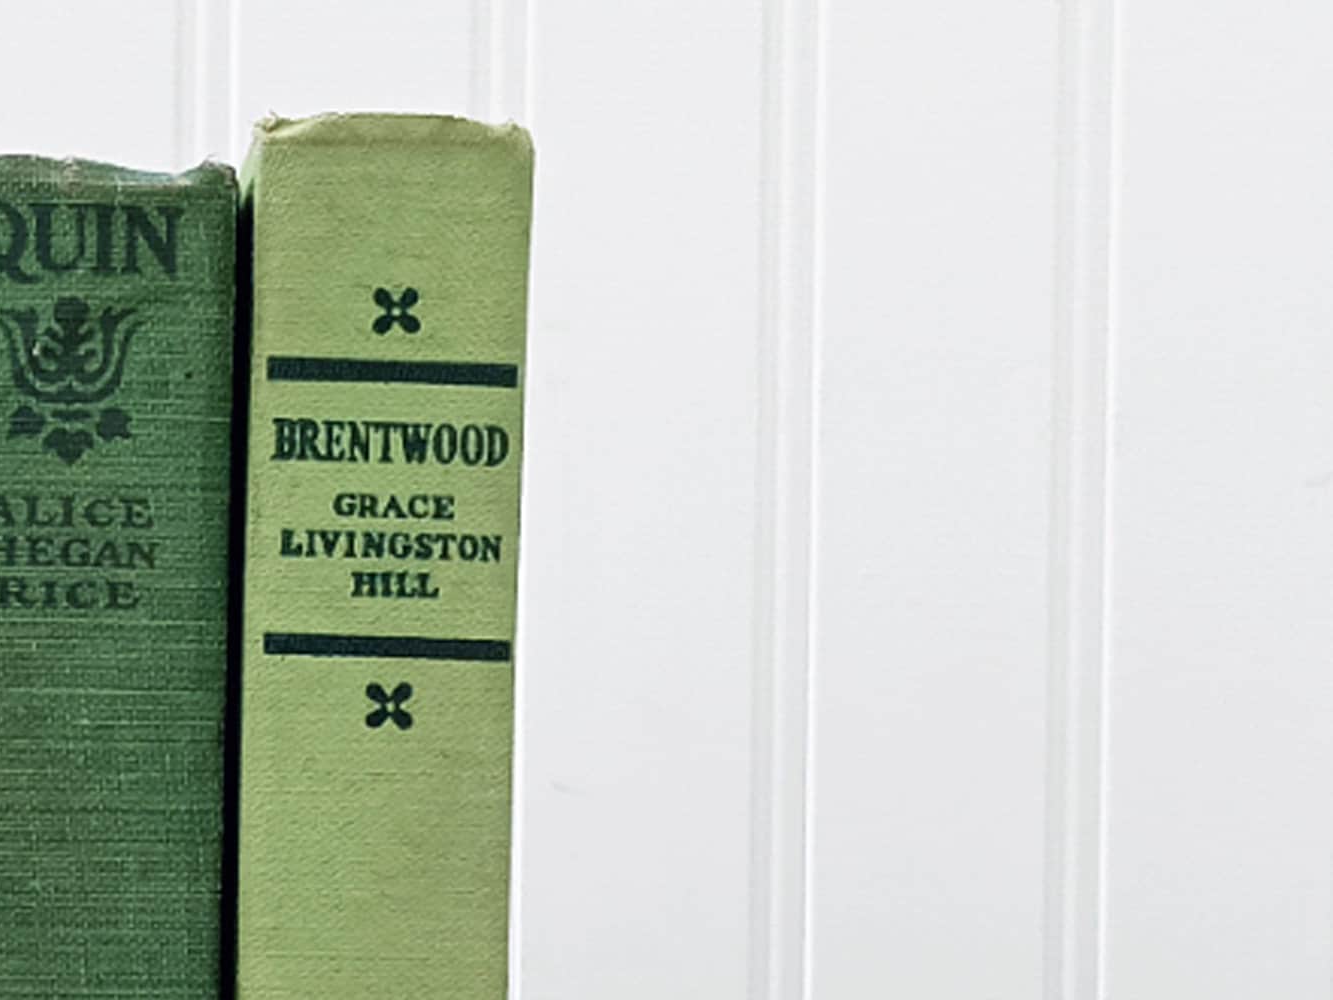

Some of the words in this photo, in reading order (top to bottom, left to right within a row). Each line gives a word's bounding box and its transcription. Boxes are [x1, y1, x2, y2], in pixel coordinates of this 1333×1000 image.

[272, 418, 509, 467] BRENTWOOD
[333, 493, 456, 520] GRACE
[280, 530, 503, 562] LIVINGSTON
[351, 571, 440, 599] HILL
